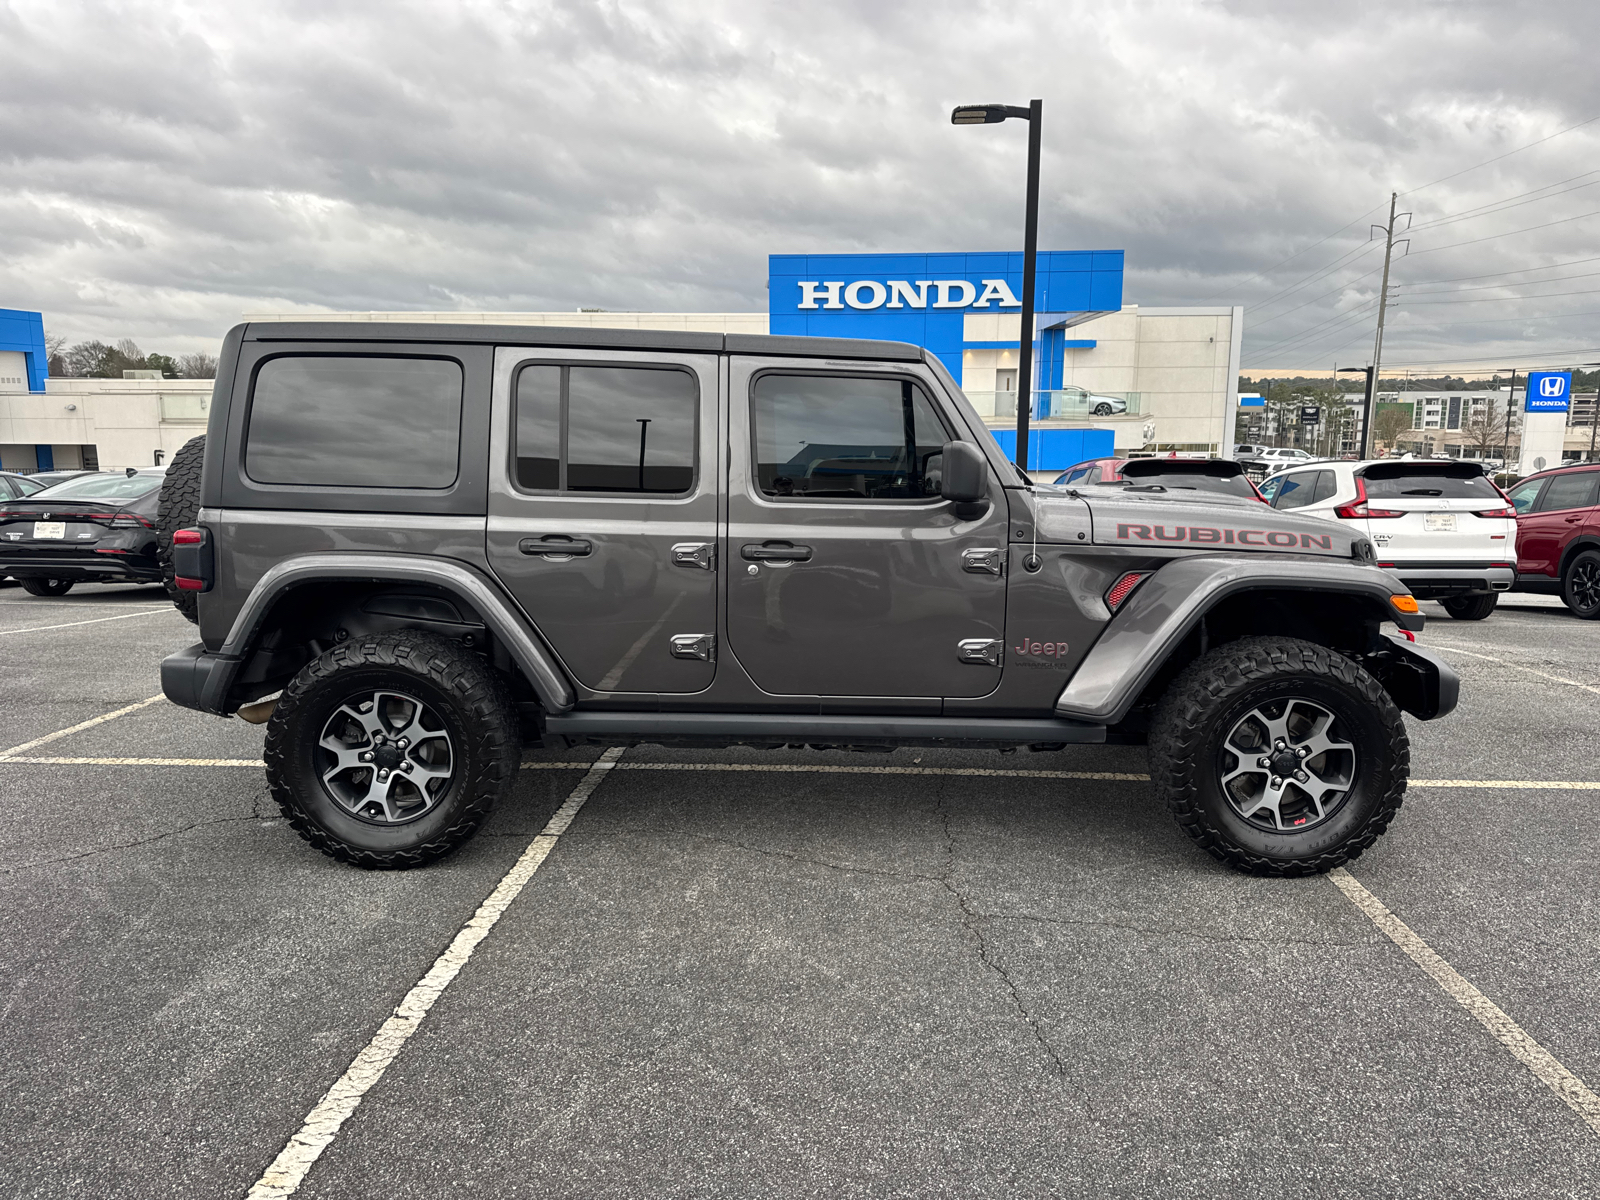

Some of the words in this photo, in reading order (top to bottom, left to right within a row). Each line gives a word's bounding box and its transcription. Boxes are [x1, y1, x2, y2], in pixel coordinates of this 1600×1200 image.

[797, 278, 1023, 310] HONDA
[1116, 523, 1333, 550] RUBICON
[1015, 638, 1069, 659] Jeep
